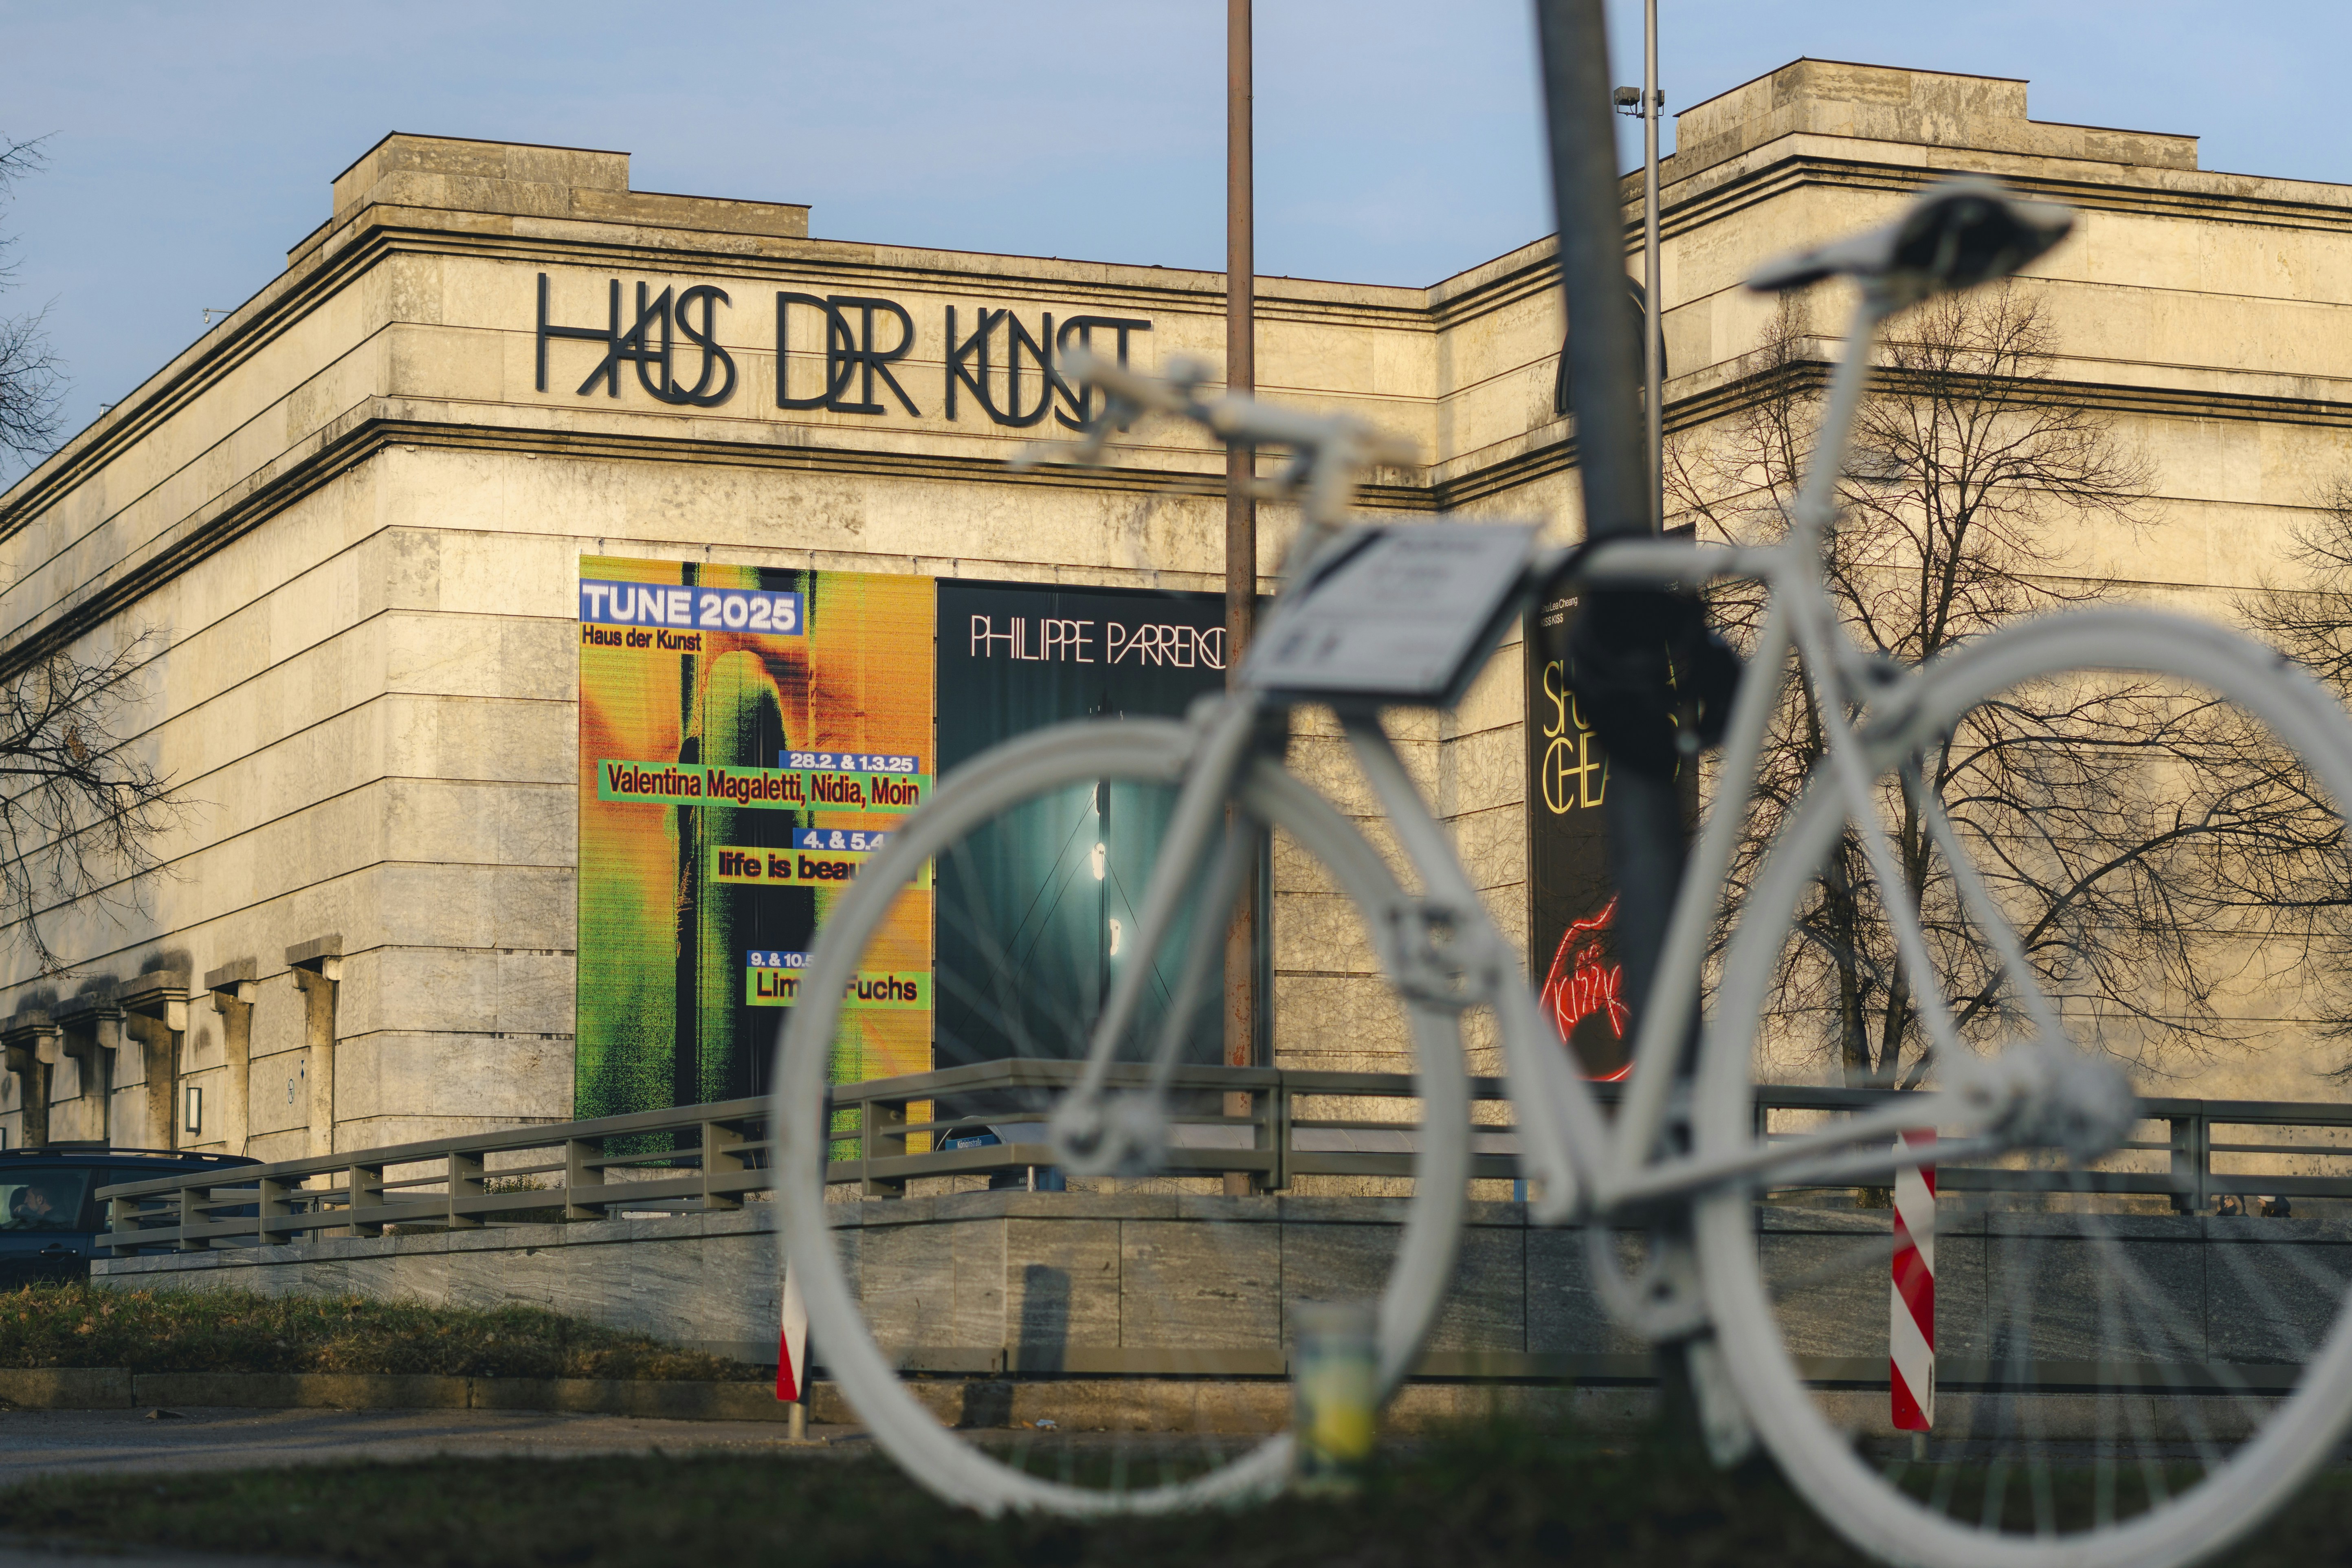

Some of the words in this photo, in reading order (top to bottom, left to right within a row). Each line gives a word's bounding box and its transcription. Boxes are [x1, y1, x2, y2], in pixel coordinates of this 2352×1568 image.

[776, 291, 921, 417] DER
[582, 584, 691, 624] TUNE
[700, 595, 795, 630] 2025
[1550, 602, 1559, 611] Lea
[1559, 597, 1578, 609] Cheang
[582, 625, 622, 647] Haus
[626, 627, 653, 649] der
[657, 629, 702, 652] Kunst
[972, 615, 1094, 662] PHILIPPE
[790, 753, 836, 770] 28.2.
[841, 757, 856, 770] &
[859, 757, 913, 772] 1.3.25
[607, 763, 701, 796] Valentina
[707, 769, 806, 807] Magaletti,
[811, 773, 866, 808] Nídia,
[871, 776, 919, 806] Moin
[803, 831, 824, 849] 4.
[829, 831, 846, 849] &
[718, 851, 761, 877] life
[768, 853, 791, 879] is
[751, 952, 765, 966] 9.
[769, 953, 781, 967] &
[957, 1137, 982, 1149] Königinstraße
